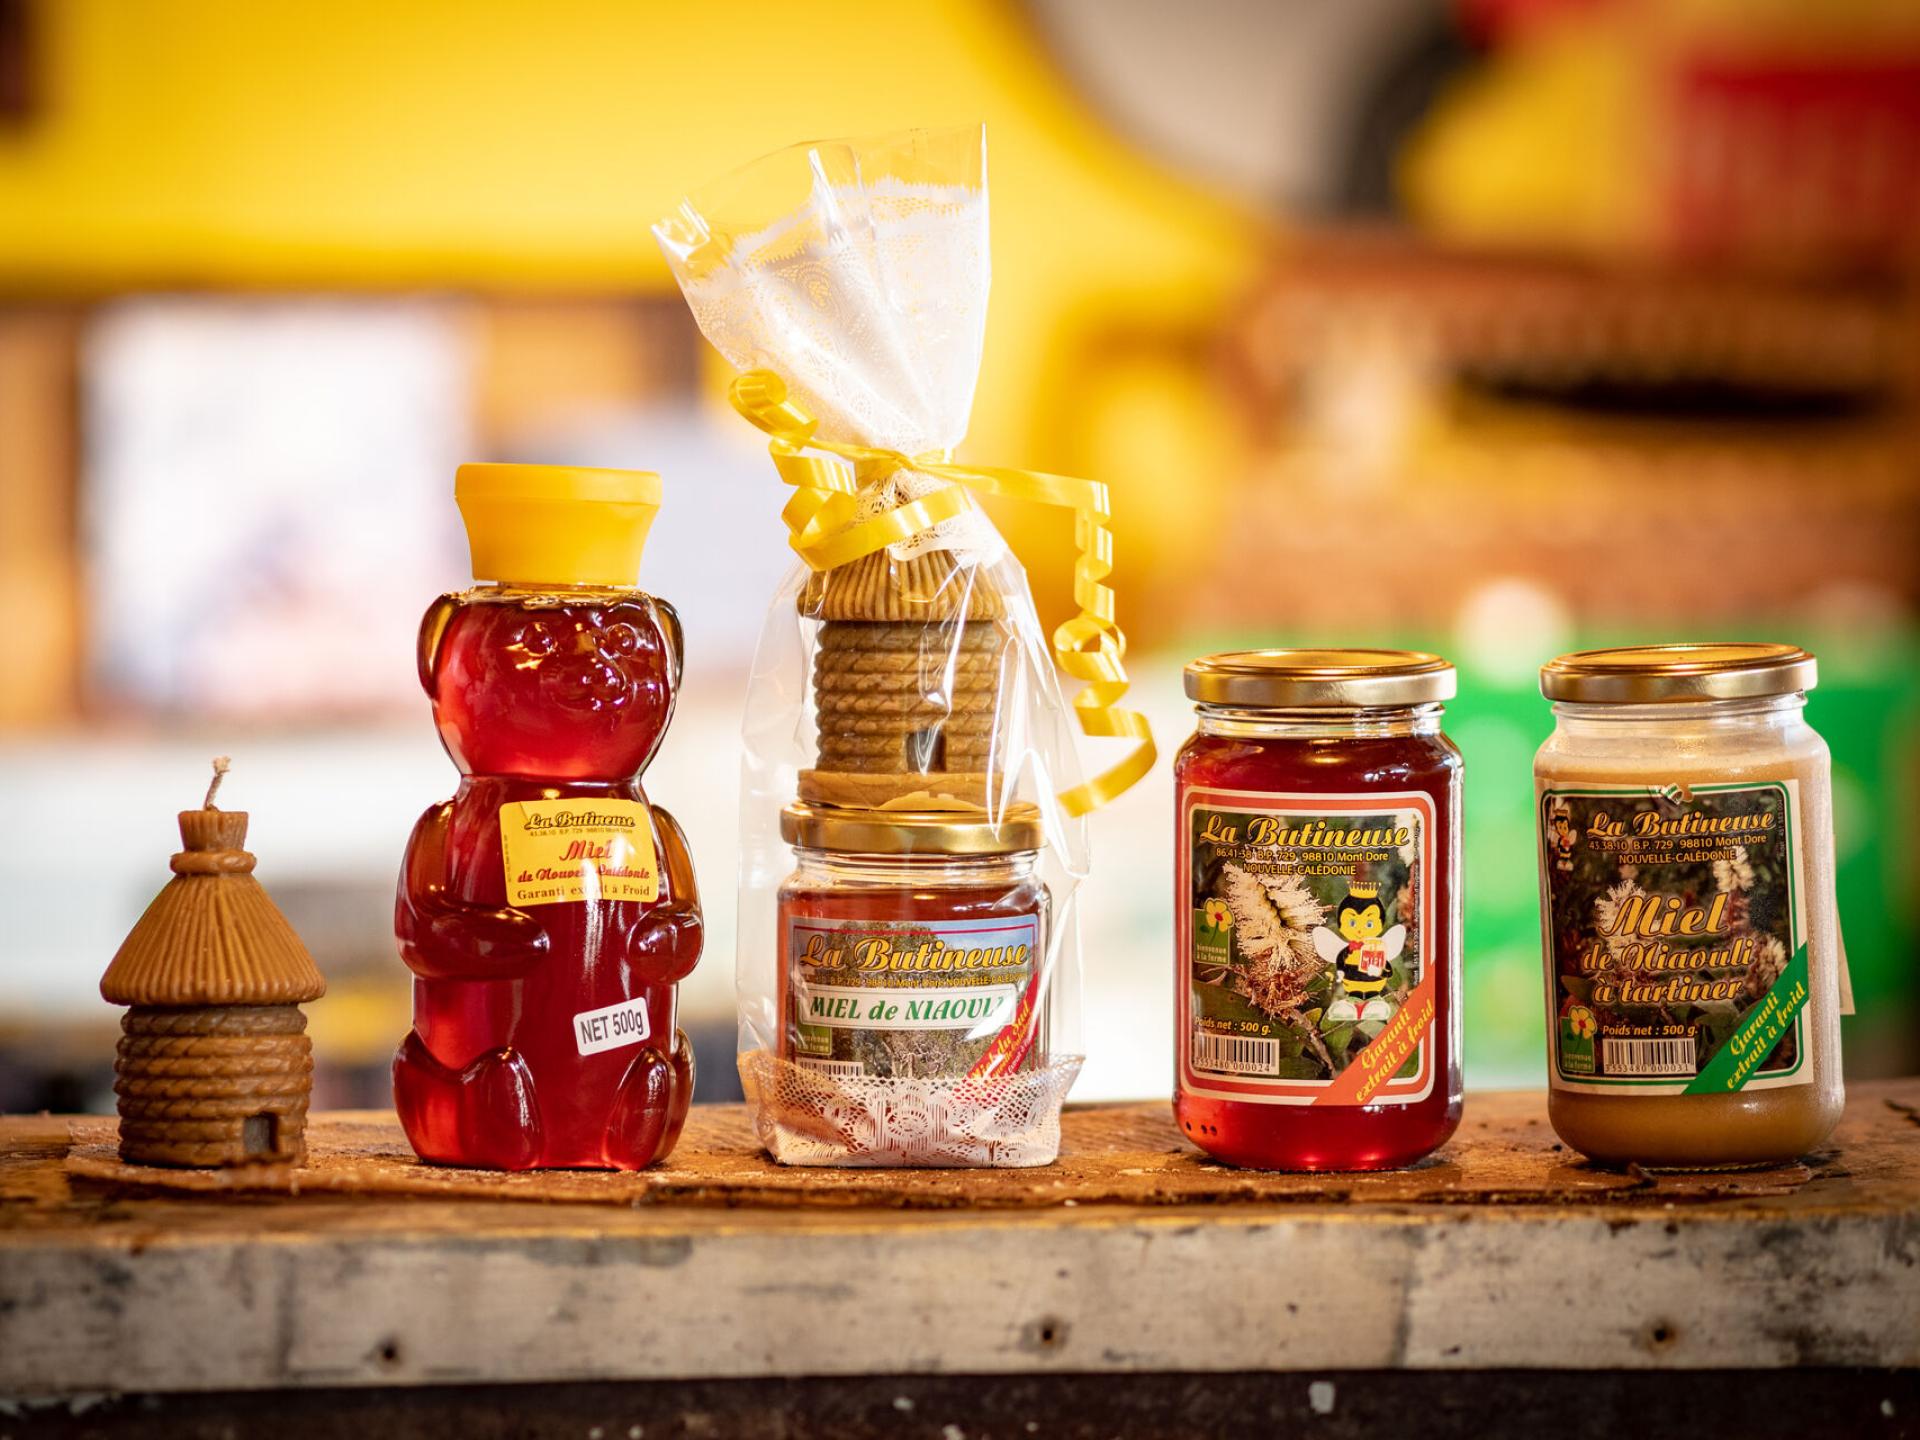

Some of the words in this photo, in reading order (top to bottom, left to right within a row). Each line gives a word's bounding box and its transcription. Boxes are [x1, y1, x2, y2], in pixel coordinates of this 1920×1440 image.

[524, 813, 552, 830] La
[555, 811, 636, 828] Butineuse
[1200, 815, 1239, 845] La
[1247, 817, 1411, 850] Butineuse
[1586, 811, 1627, 838] La
[1632, 811, 1775, 837] Butineuse
[559, 839, 612, 861] Miel
[1654, 840, 1673, 850] 729
[1679, 838, 1713, 849] 98810
[1715, 836, 1742, 847] Mont
[1744, 834, 1767, 844] Dore
[1278, 852, 1296, 861] 729
[1302, 852, 1335, 862] 98810
[1337, 852, 1363, 862] Mont
[1365, 852, 1389, 862] Dore
[517, 870, 533, 883] de
[517, 885, 566, 900] Garanti
[623, 884, 650, 896] Froid
[1600, 892, 1730, 938] Miel
[799, 934, 845, 969] La
[853, 936, 1028, 973] Butineuse
[1584, 944, 1614, 971] de
[1620, 938, 1755, 972] Niaouli
[1594, 977, 1614, 1003] à
[1620, 975, 1744, 1004] tartiner
[810, 997, 861, 1019] MIEL
[868, 1000, 899, 1020] de
[580, 1015, 609, 1045] NET
[612, 1009, 645, 1036] 500g
[1217, 1021, 1232, 1030] net
[1240, 1021, 1259, 1032] 500
[1261, 1025, 1272, 1036] g.
[1602, 1025, 1631, 1036] Poids
[1633, 1026, 1652, 1036] net
[1662, 1025, 1685, 1036] 500
[1687, 1026, 1699, 1037] g.
[1727, 1036, 1768, 1089] extrait
[1775, 980, 1805, 1027] froid
[1730, 991, 1779, 1056] Garanti
[1355, 1051, 1398, 1102] extrait
[1396, 1040, 1408, 1055] à
[1407, 998, 1434, 1045] froid
[1361, 1007, 1410, 1069] Garanti
